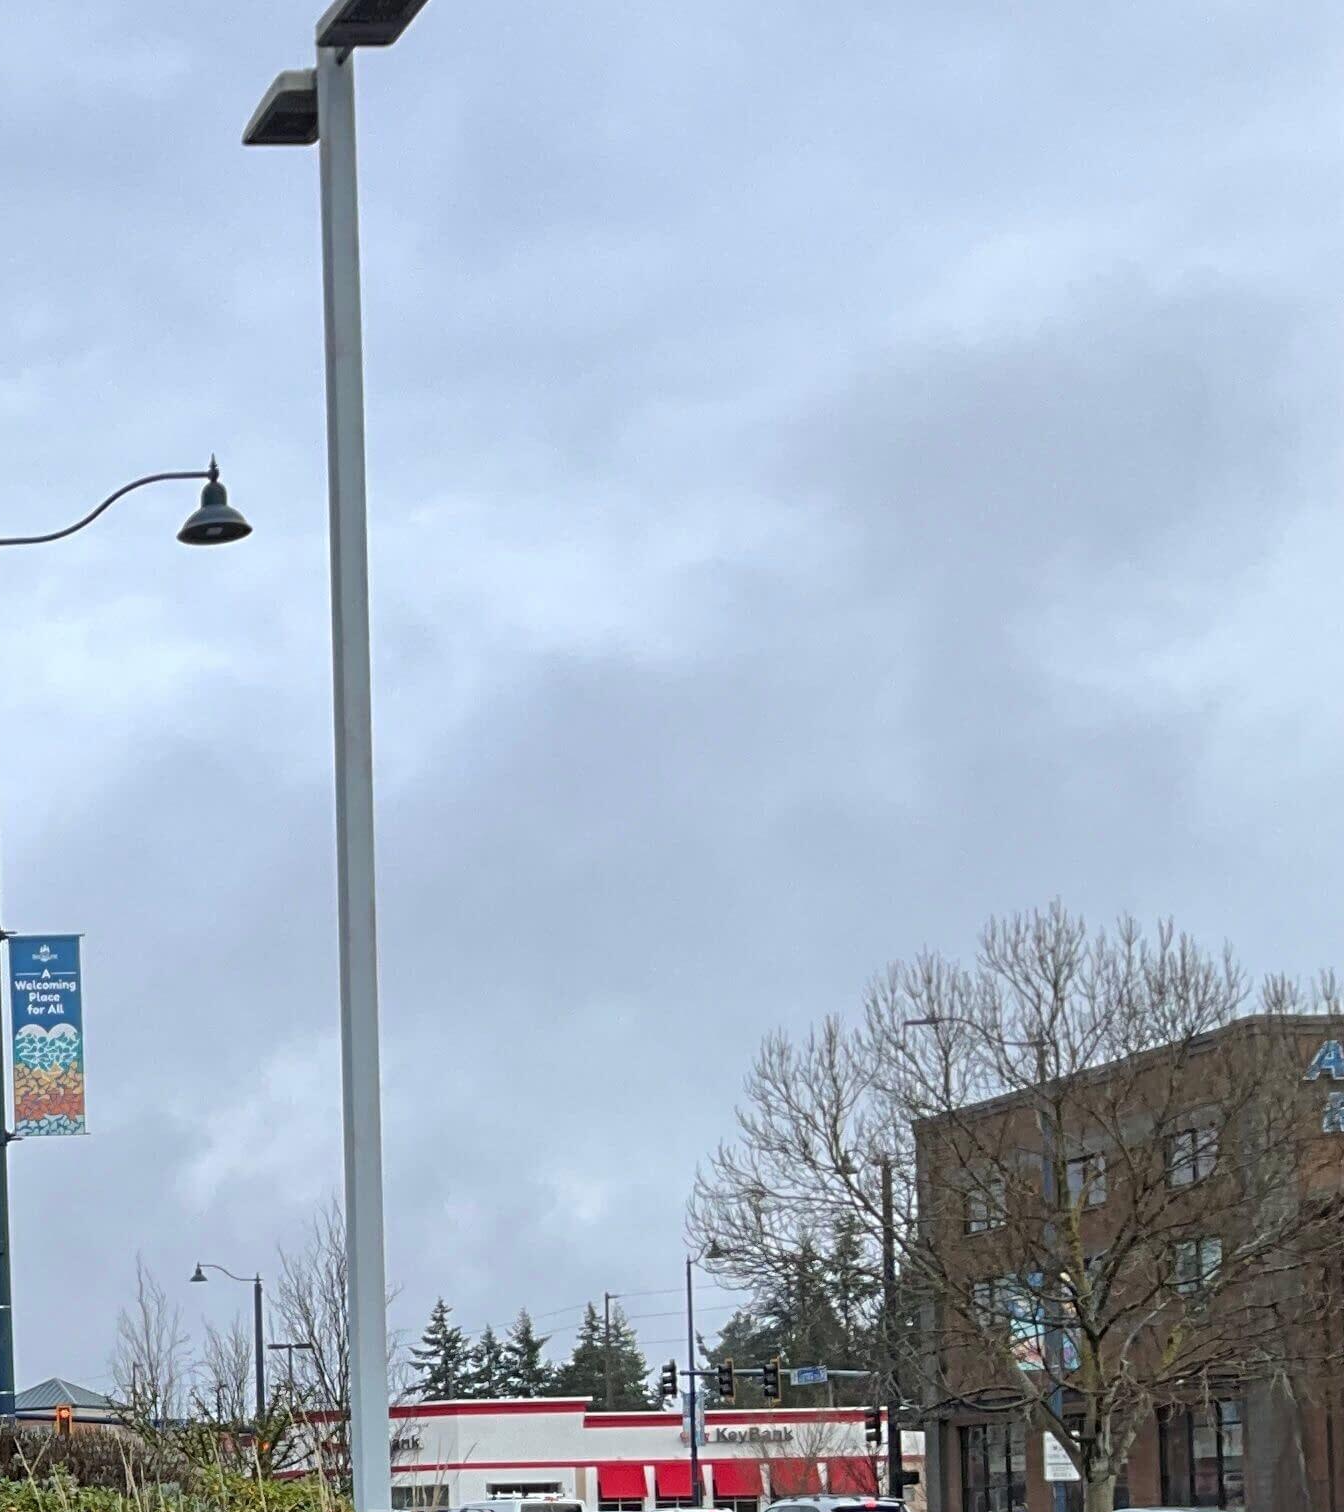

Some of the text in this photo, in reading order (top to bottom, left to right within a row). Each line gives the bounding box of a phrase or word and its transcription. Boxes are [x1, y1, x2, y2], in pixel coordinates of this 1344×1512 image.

[41, 968, 51, 979] A
[14, 980, 76, 992] Welcoming
[28, 992, 60, 1002] Place
[27, 1004, 64, 1015] for All
[716, 1427, 794, 1444] KeyBank
